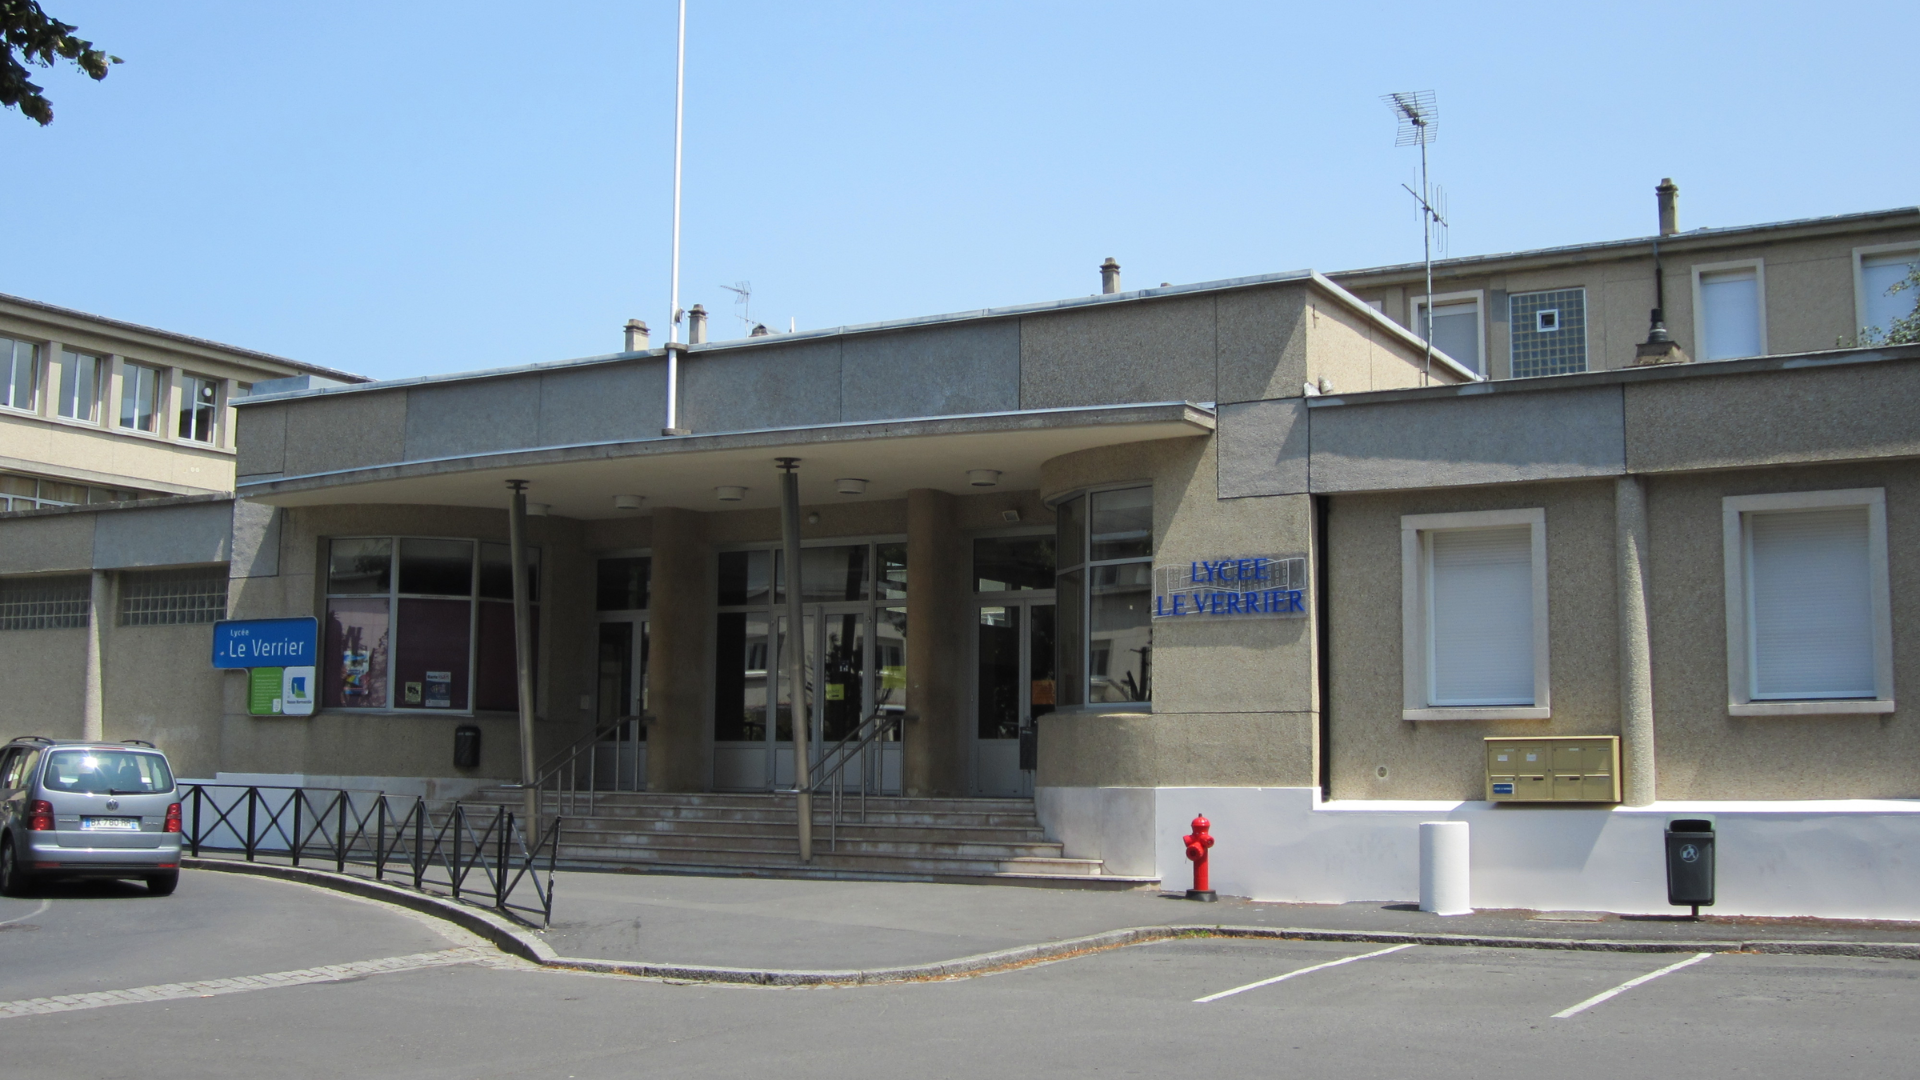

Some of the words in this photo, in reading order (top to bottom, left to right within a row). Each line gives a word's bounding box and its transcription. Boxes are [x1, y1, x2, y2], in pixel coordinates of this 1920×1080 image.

[1192, 558, 1269, 582] LYCEE
[1156, 594, 1187, 616] LE
[1193, 590, 1305, 615] VERRIER
[230, 629, 249, 638] Lycée
[229, 640, 246, 658] Le
[252, 637, 304, 657] Verrier
